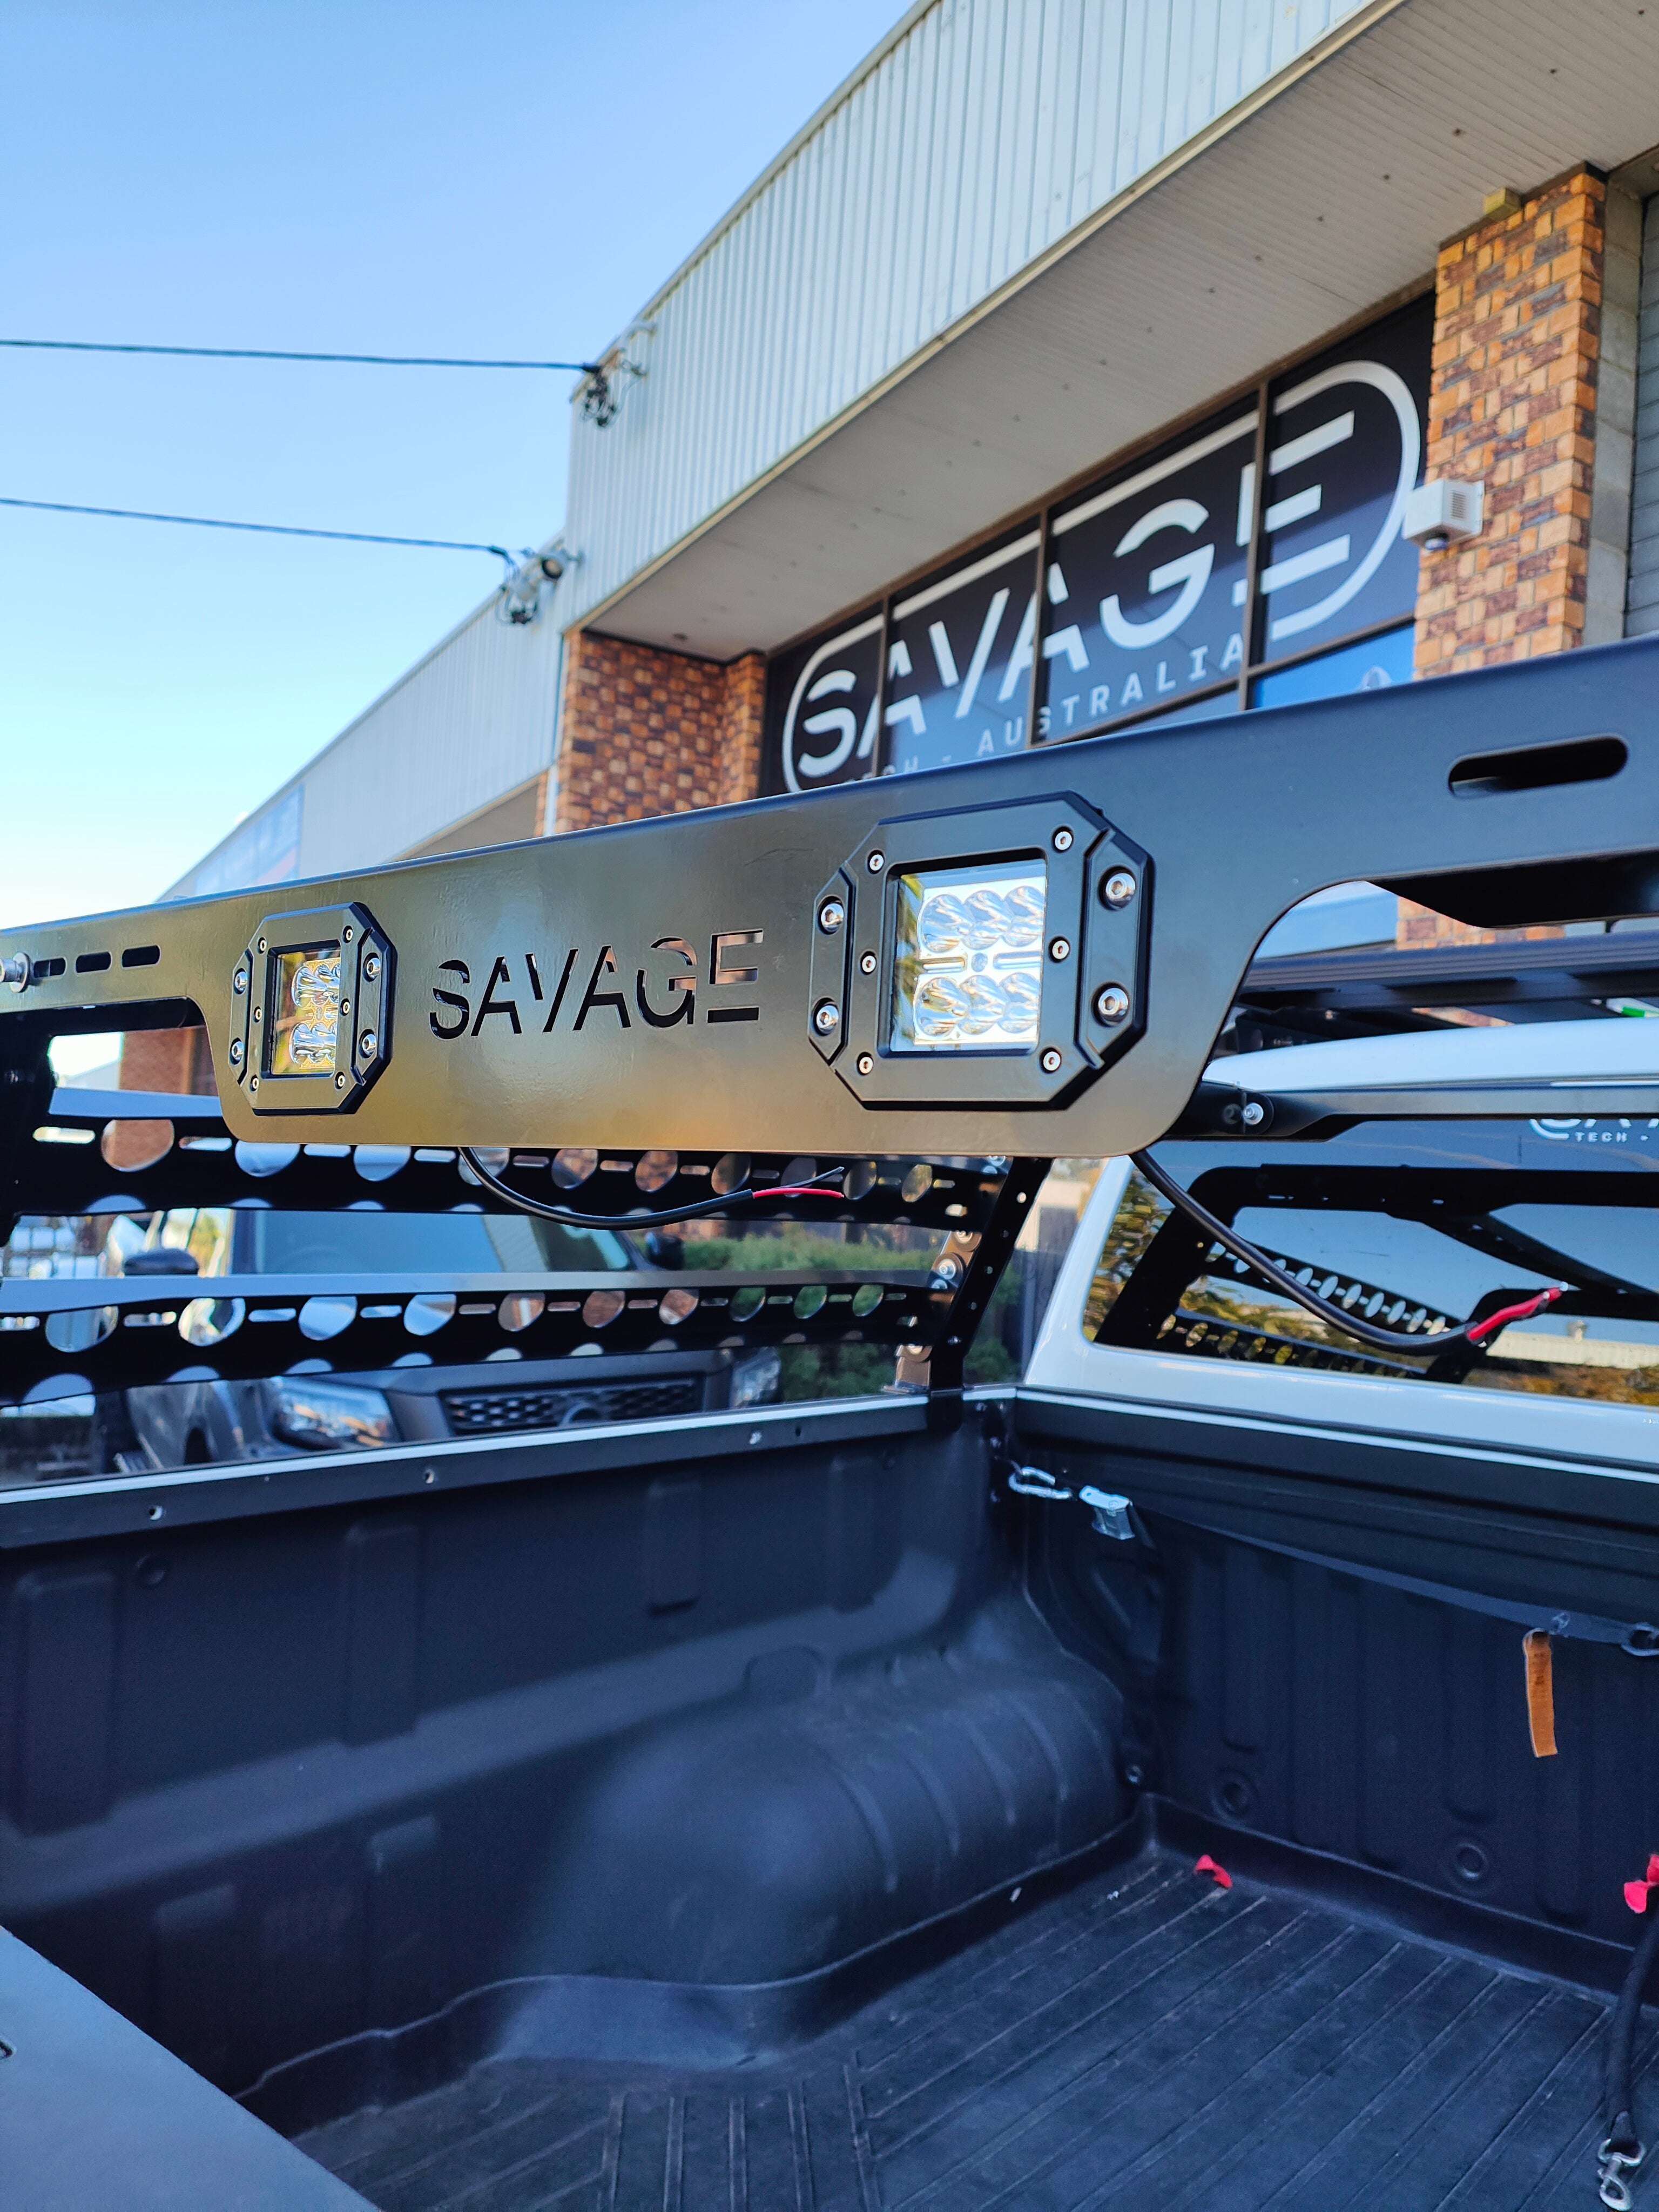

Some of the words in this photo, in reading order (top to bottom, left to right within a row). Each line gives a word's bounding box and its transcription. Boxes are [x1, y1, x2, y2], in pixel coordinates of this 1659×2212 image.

[798, 409, 1354, 778] SAVAGE
[977, 631, 1243, 757] AUSTRALIA
[429, 928, 764, 1040] SAVAGE
[1575, 1131, 1628, 1143] TECH
